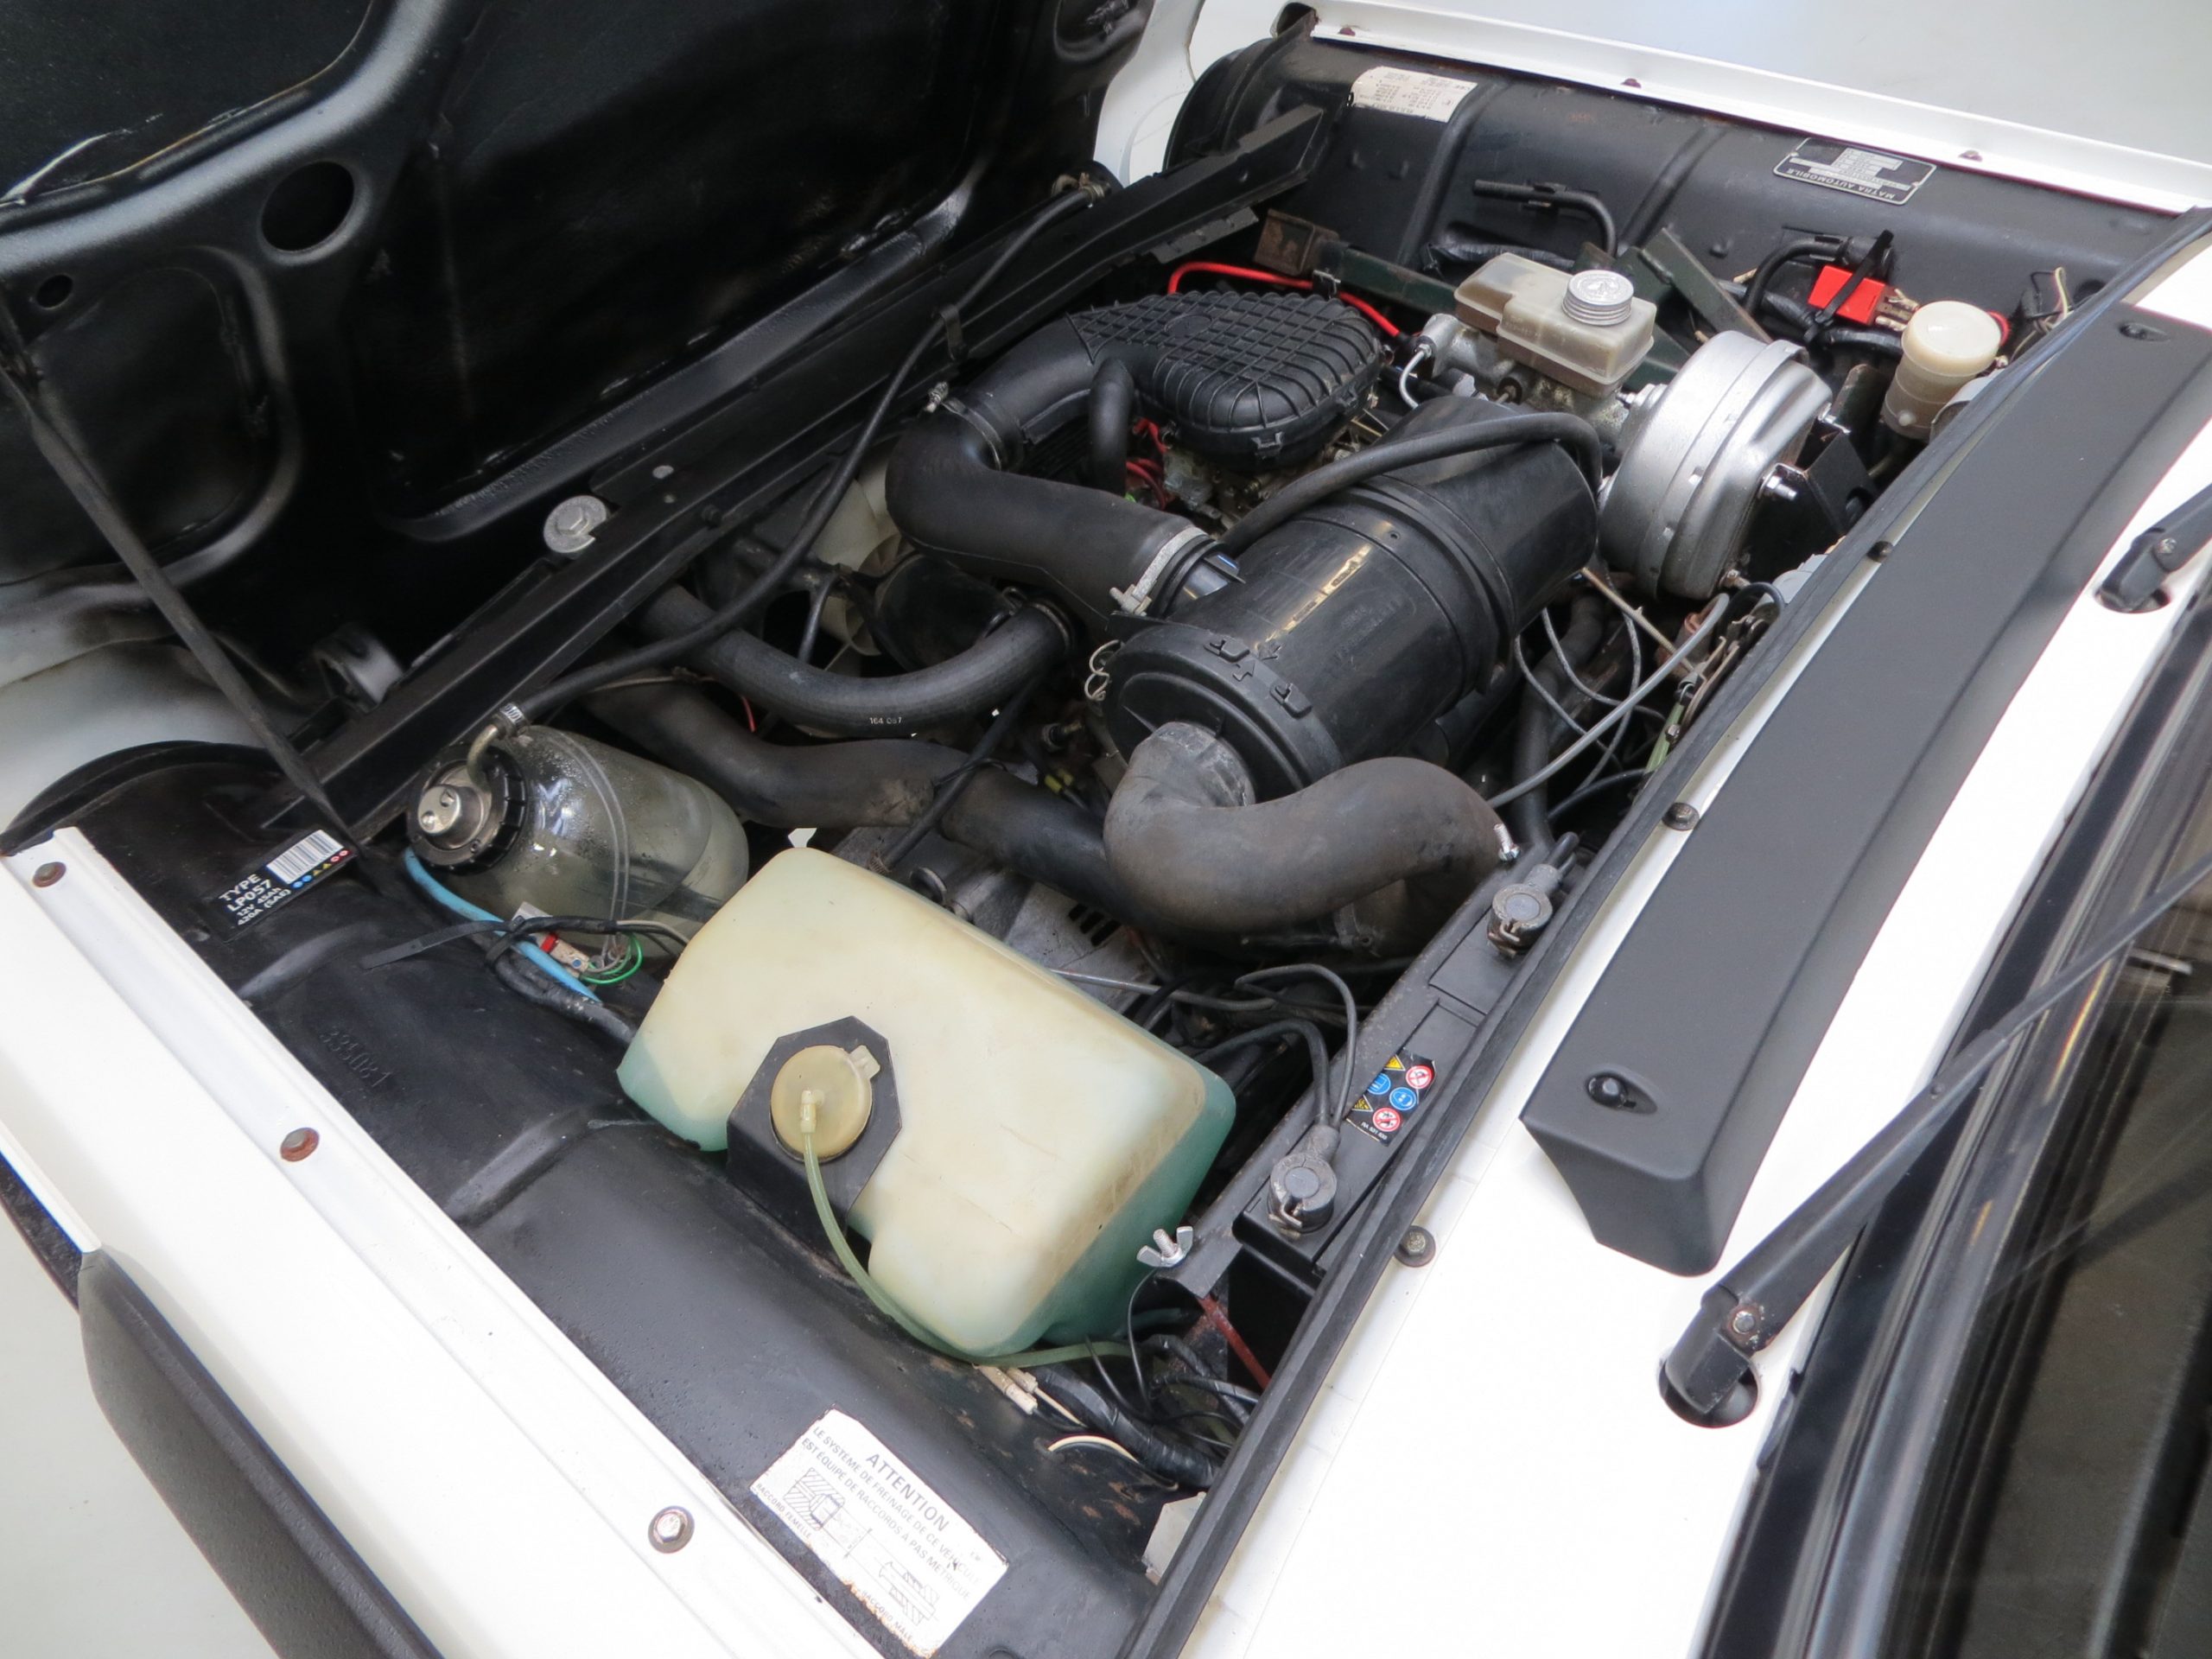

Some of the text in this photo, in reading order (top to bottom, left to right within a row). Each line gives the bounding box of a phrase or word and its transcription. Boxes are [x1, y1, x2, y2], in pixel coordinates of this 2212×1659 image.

[1785, 167, 1855, 189] AUTOMOBILE
[1858, 185, 1895, 200] MATRA
[219, 873, 262, 901] TYPE
[226, 879, 272, 912] LP057
[237, 888, 292, 926] 420A (SAE)
[237, 903, 255, 917] 12V
[799, 1437, 819, 1456] EST
[842, 1477, 859, 1493] DE
[855, 1488, 904, 1535] RACCORDS
[907, 1538, 929, 1560] PAS
[811, 1425, 826, 1440] LE
[857, 1469, 874, 1486] DE
[870, 1480, 915, 1524] FREINAGE
[911, 1519, 928, 1535] DE
[924, 1530, 941, 1548] CE
[864, 1450, 951, 1533] ATTENTION
[754, 1482, 813, 1540] RACCORD FEMELLE
